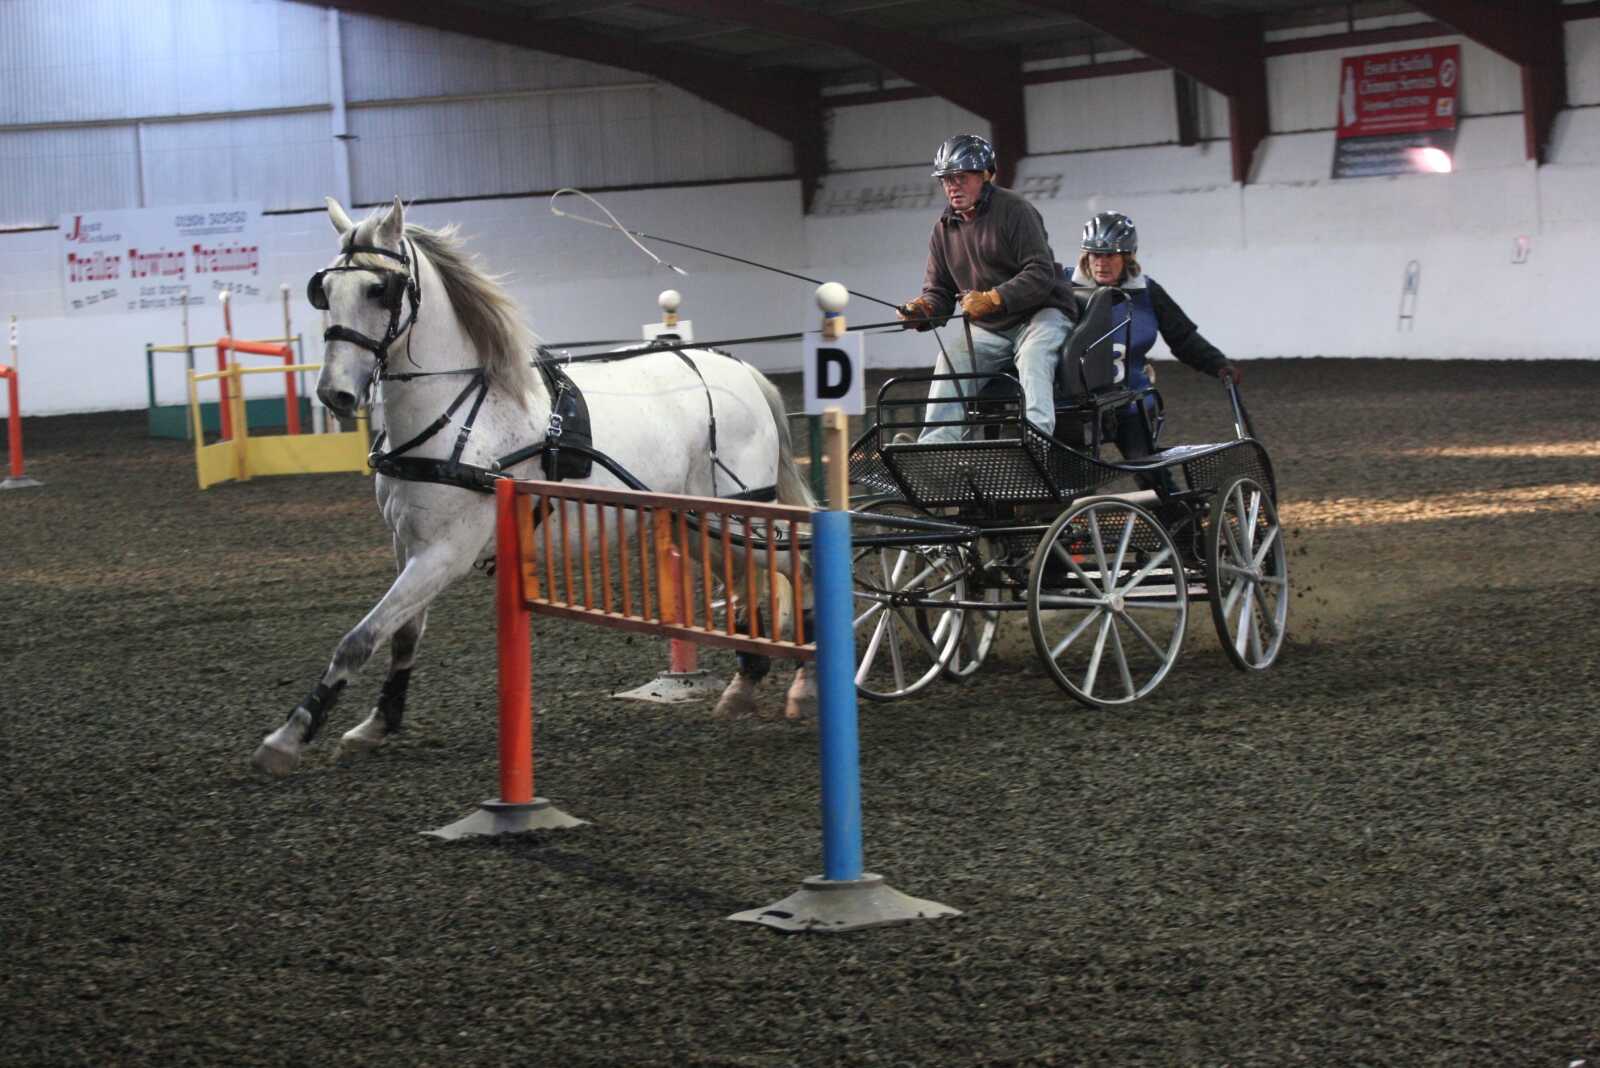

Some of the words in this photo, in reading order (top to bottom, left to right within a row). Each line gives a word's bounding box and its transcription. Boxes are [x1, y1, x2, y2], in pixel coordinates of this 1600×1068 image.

[67, 252, 120, 282] Trailer
[127, 248, 185, 280] Towing
[192, 242, 258, 276] Training
[816, 347, 853, 399] D
